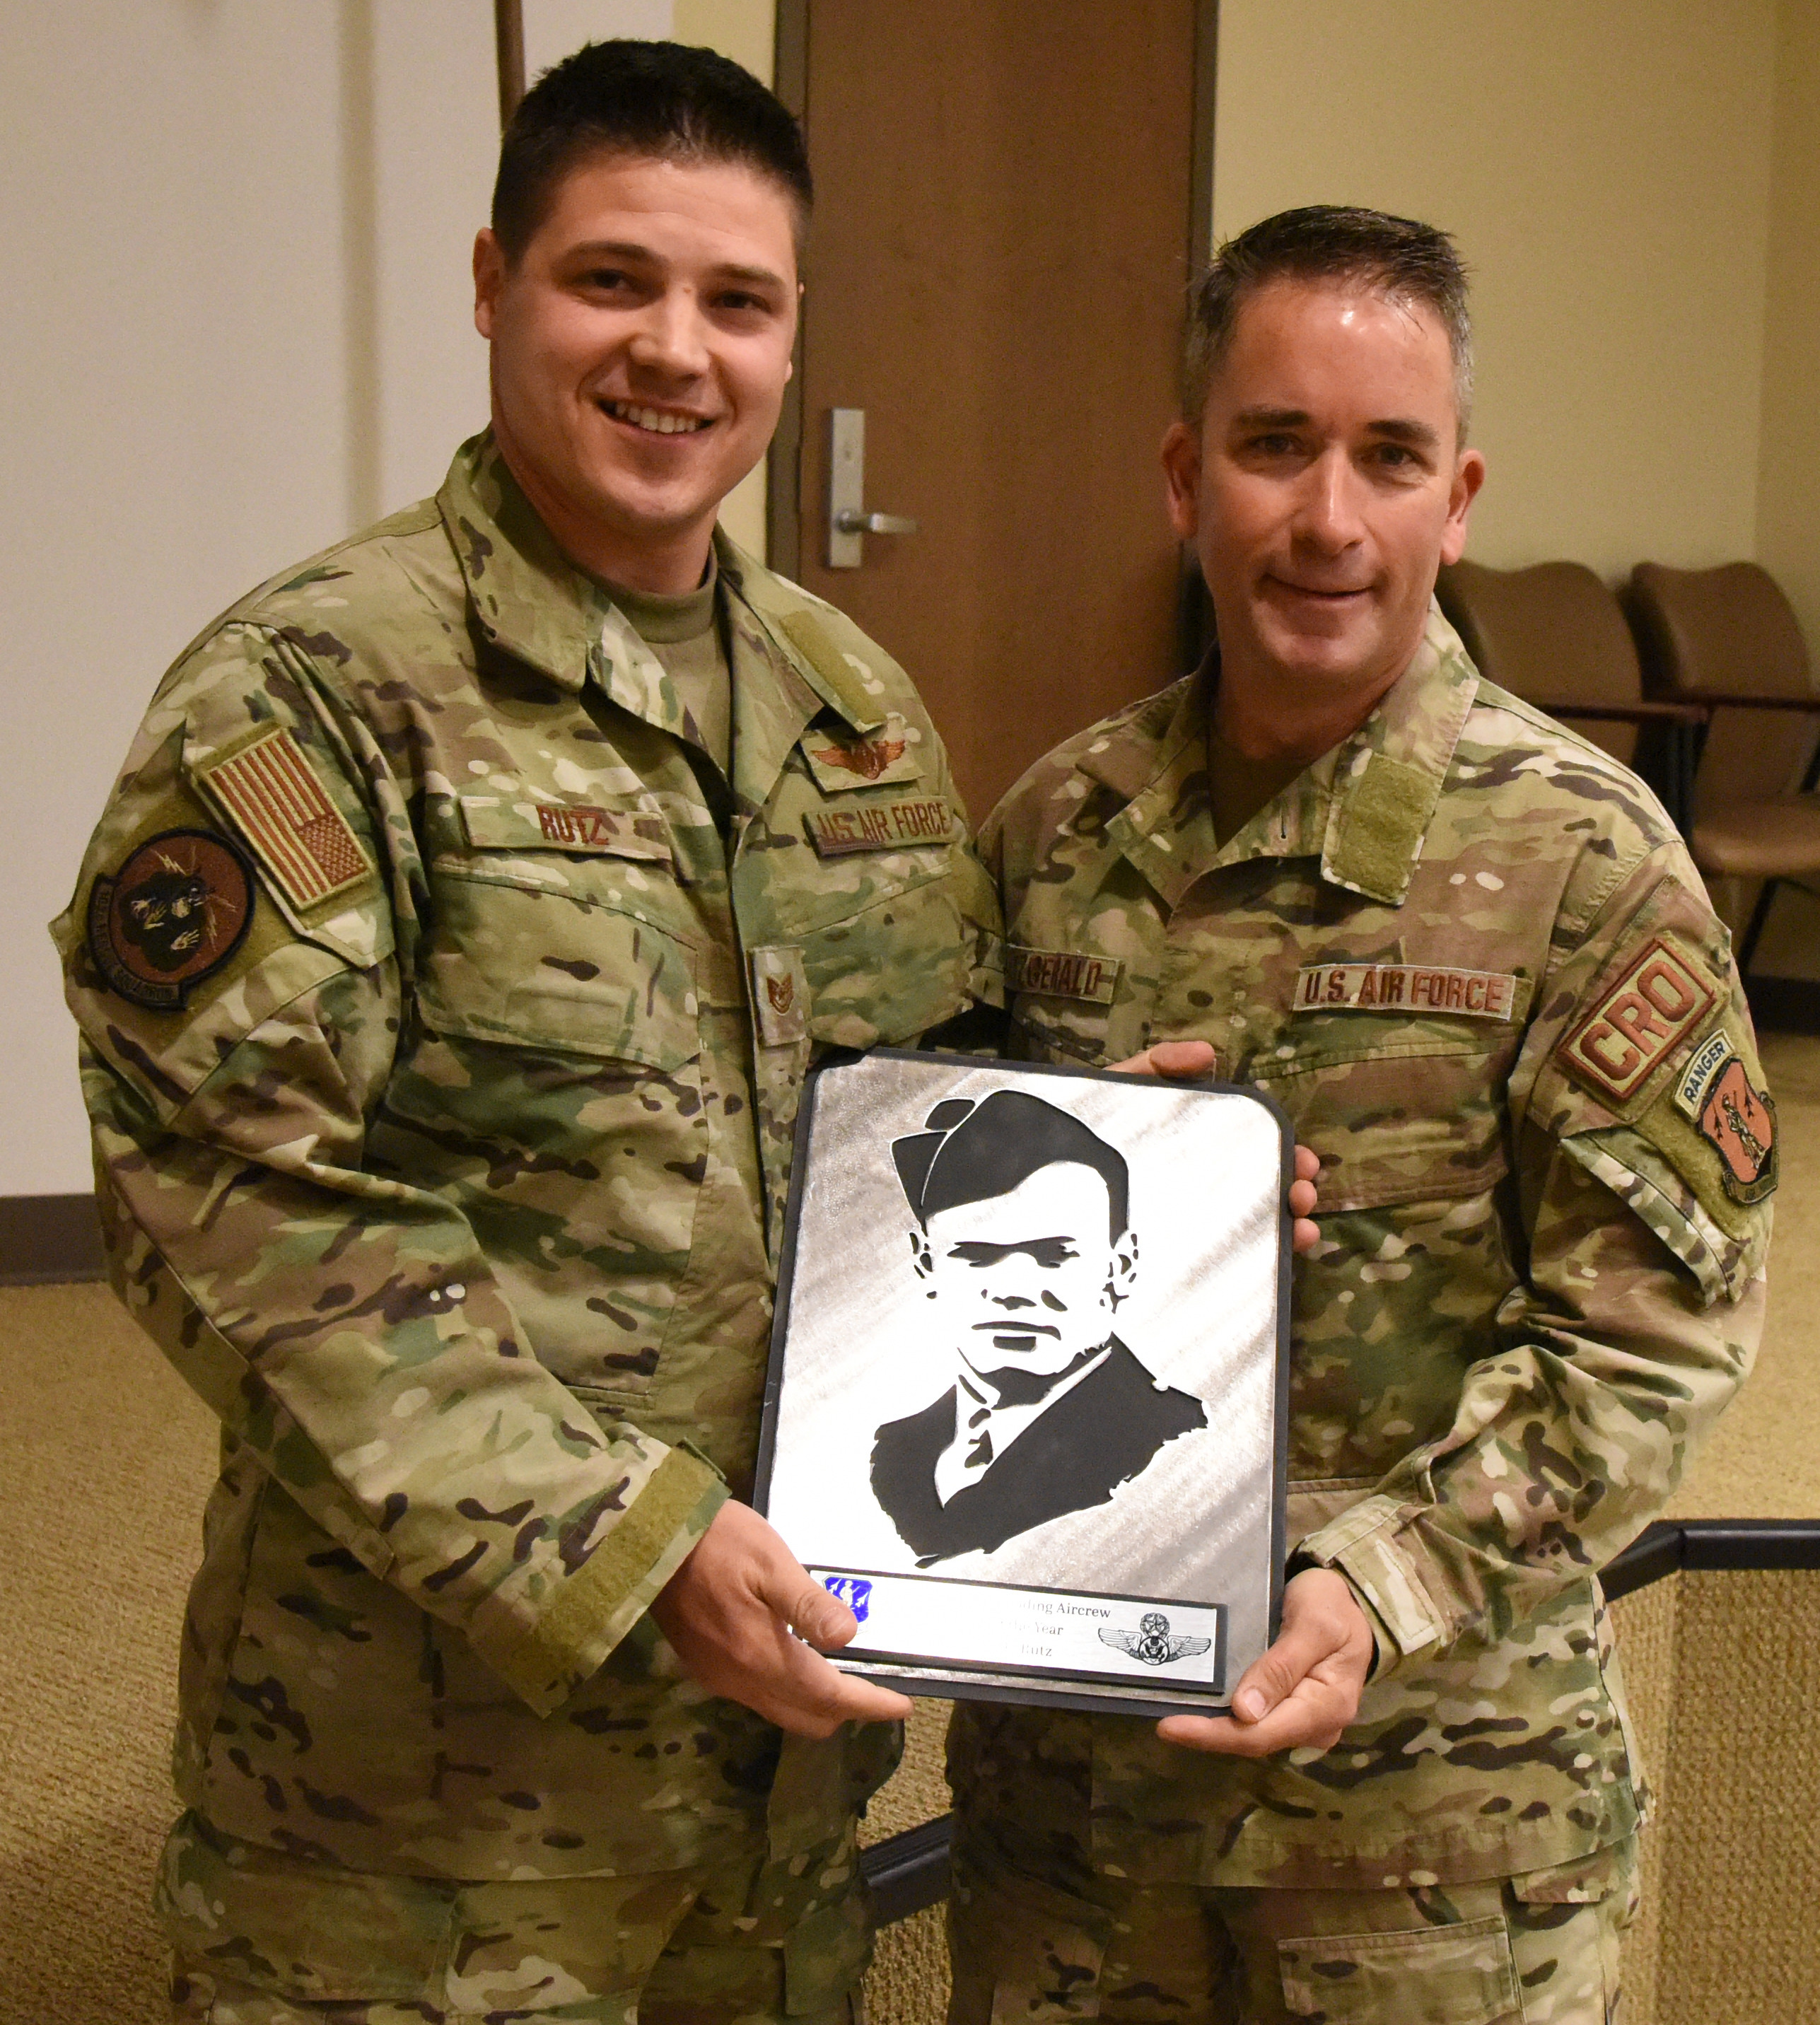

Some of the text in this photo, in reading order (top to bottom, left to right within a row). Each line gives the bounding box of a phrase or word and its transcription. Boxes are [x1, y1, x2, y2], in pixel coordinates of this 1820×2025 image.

[535, 805, 609, 846] RUTZ
[856, 808, 893, 843] AIR
[891, 802, 952, 839] FORCE
[1358, 969, 1406, 1007] AIR
[1411, 971, 1505, 1012] FORCE
[1579, 959, 1696, 1081] CRO
[1683, 1040, 1727, 1106] RANGER
[1035, 1621, 1064, 1635] Year
[1056, 1602, 1112, 1618] Aircrew
